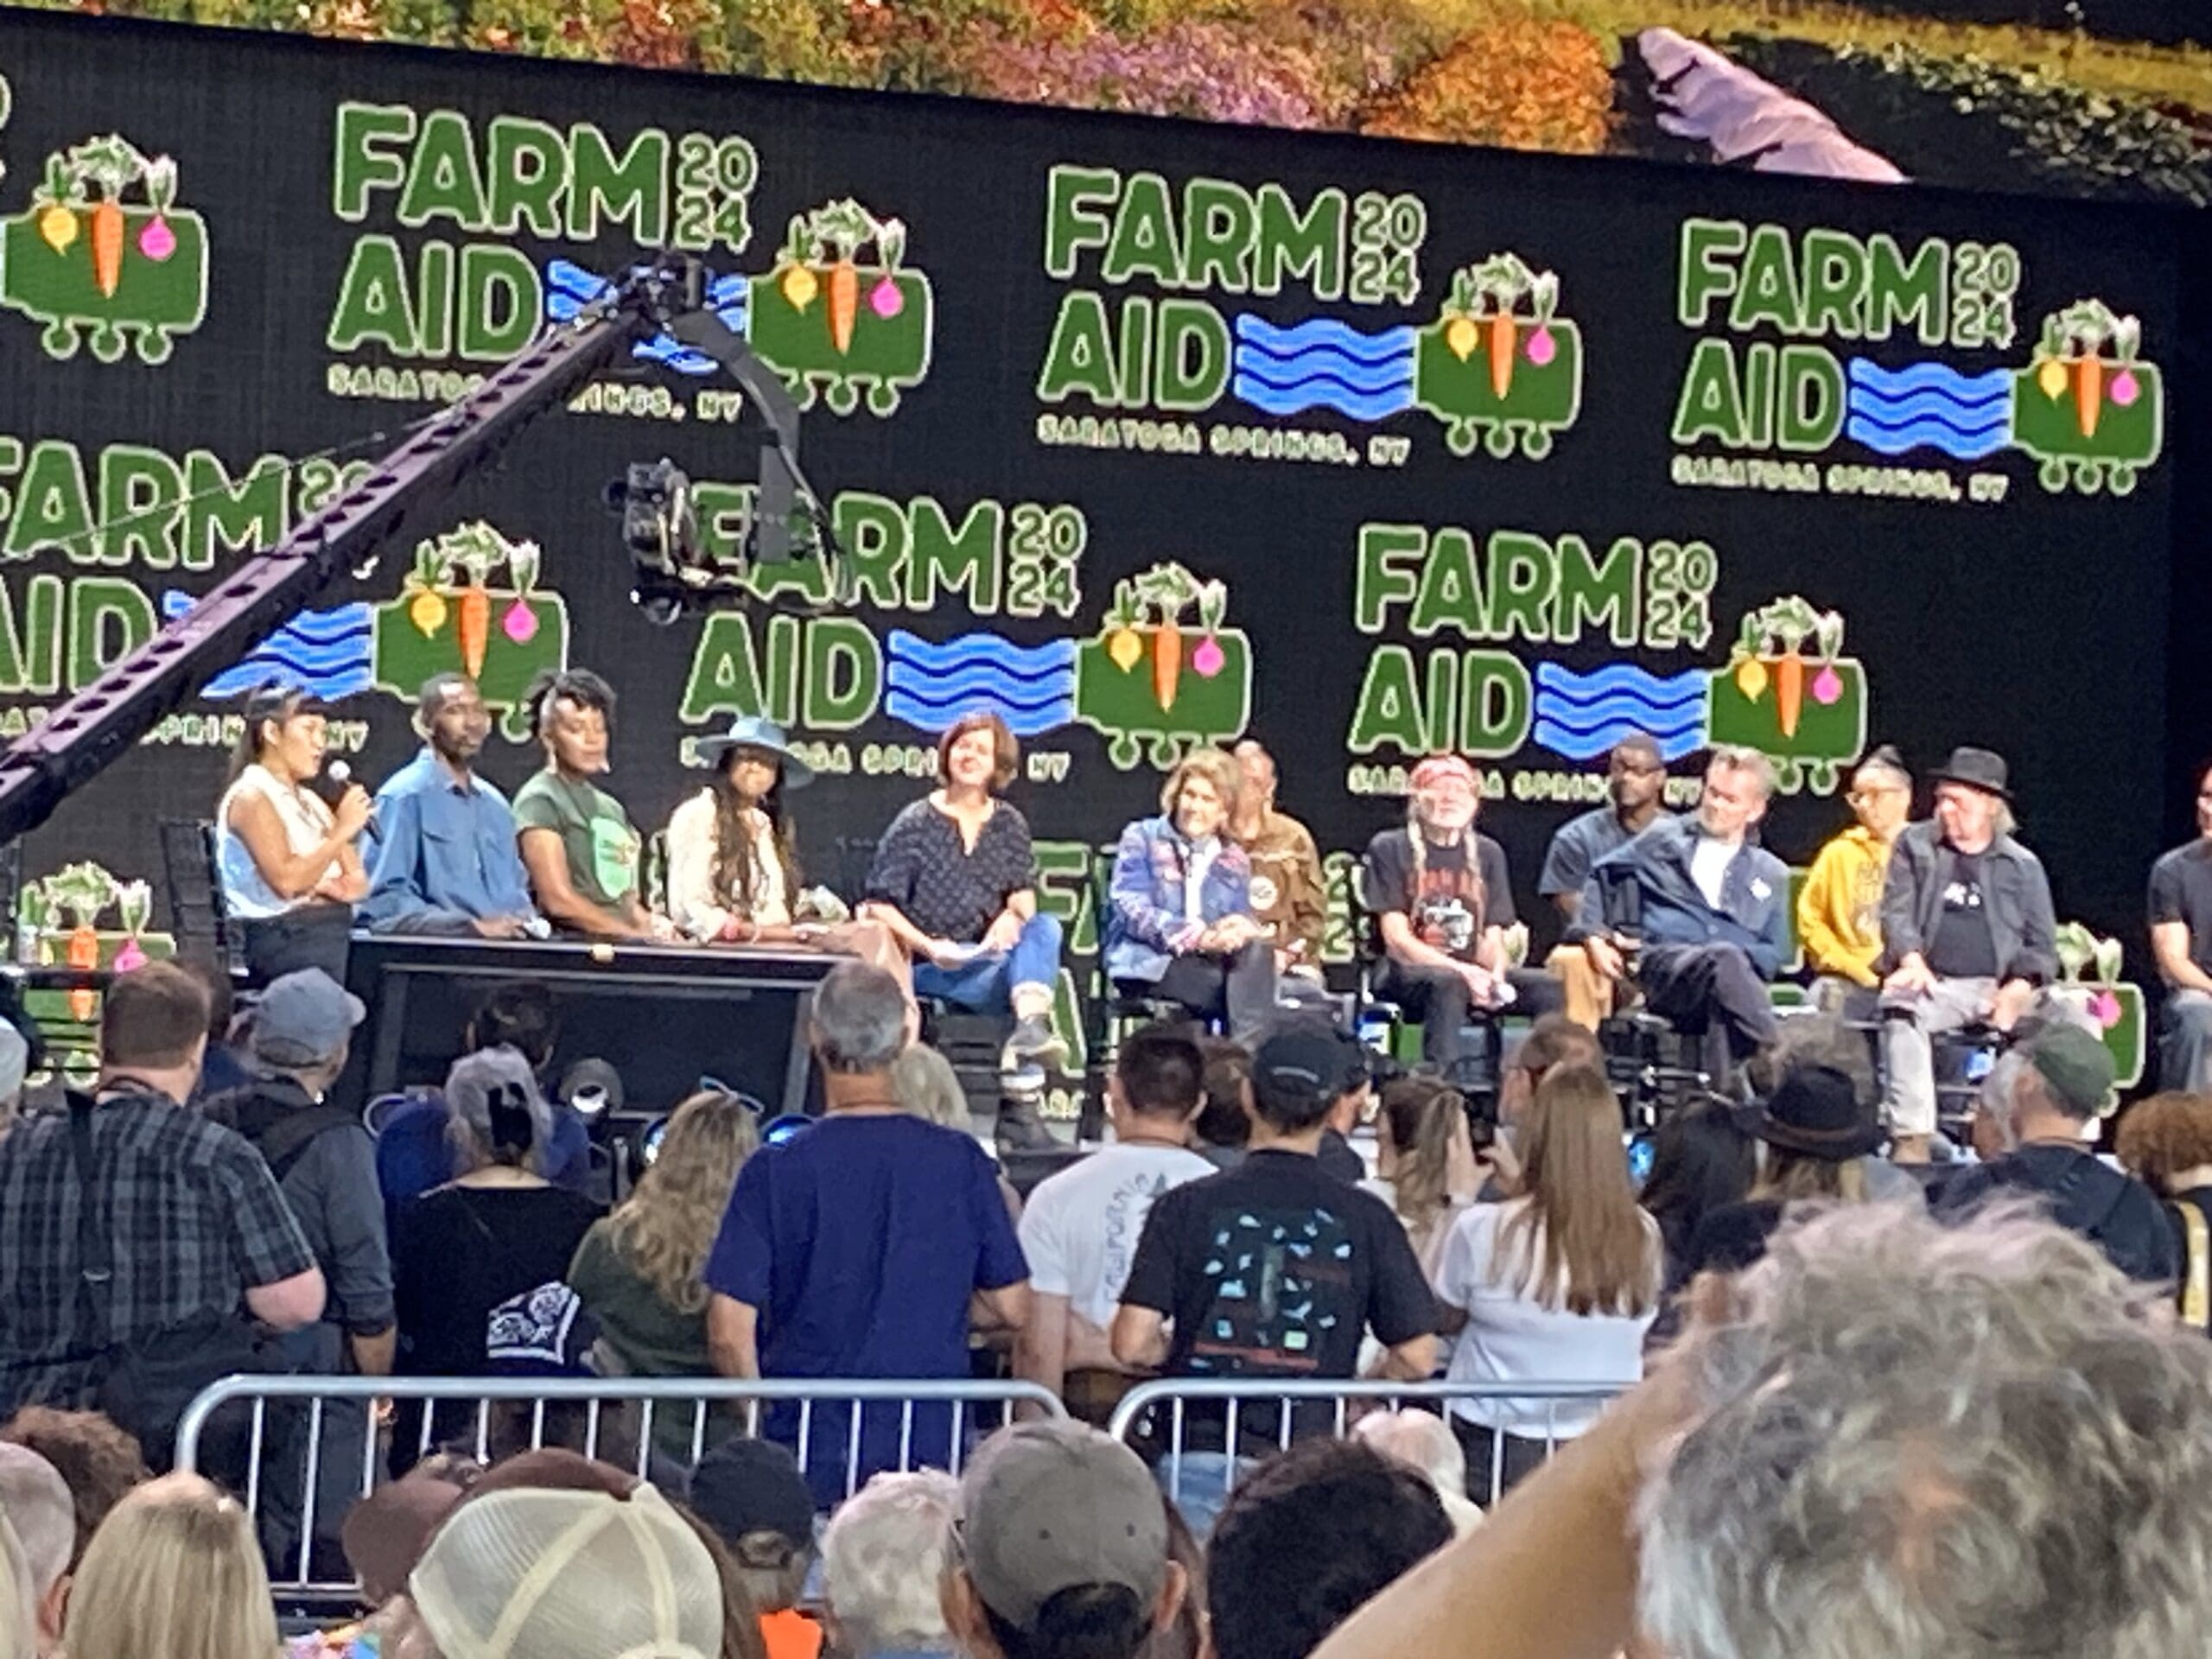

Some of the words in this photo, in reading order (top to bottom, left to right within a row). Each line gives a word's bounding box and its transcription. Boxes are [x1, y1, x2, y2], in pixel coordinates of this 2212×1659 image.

[334, 101, 670, 247] FARM
[676, 135, 759, 194] 20
[675, 191, 753, 252] 24
[1045, 164, 1347, 301] FARM
[1353, 192, 1427, 252] 20
[327, 236, 543, 361] AID
[1349, 249, 1421, 305] 24
[1678, 218, 1949, 346] FARM
[1954, 242, 2022, 296] 20
[1037, 290, 1233, 410] AID
[1950, 293, 2016, 350] 24
[696, 391, 742, 423] NY
[1671, 338, 1847, 452] AID
[1037, 415, 1202, 454] SARATOGA
[0, 436, 289, 569] ARM
[1010, 505, 1087, 561] 20
[1007, 559, 1081, 616] 24
[1355, 524, 1641, 646] FARM
[1648, 542, 1718, 595] 20
[0, 575, 158, 694] ID
[1644, 594, 1712, 649] 24
[679, 611, 884, 729] AID
[1348, 646, 1533, 759] AID
[1027, 751, 1071, 781] NY
